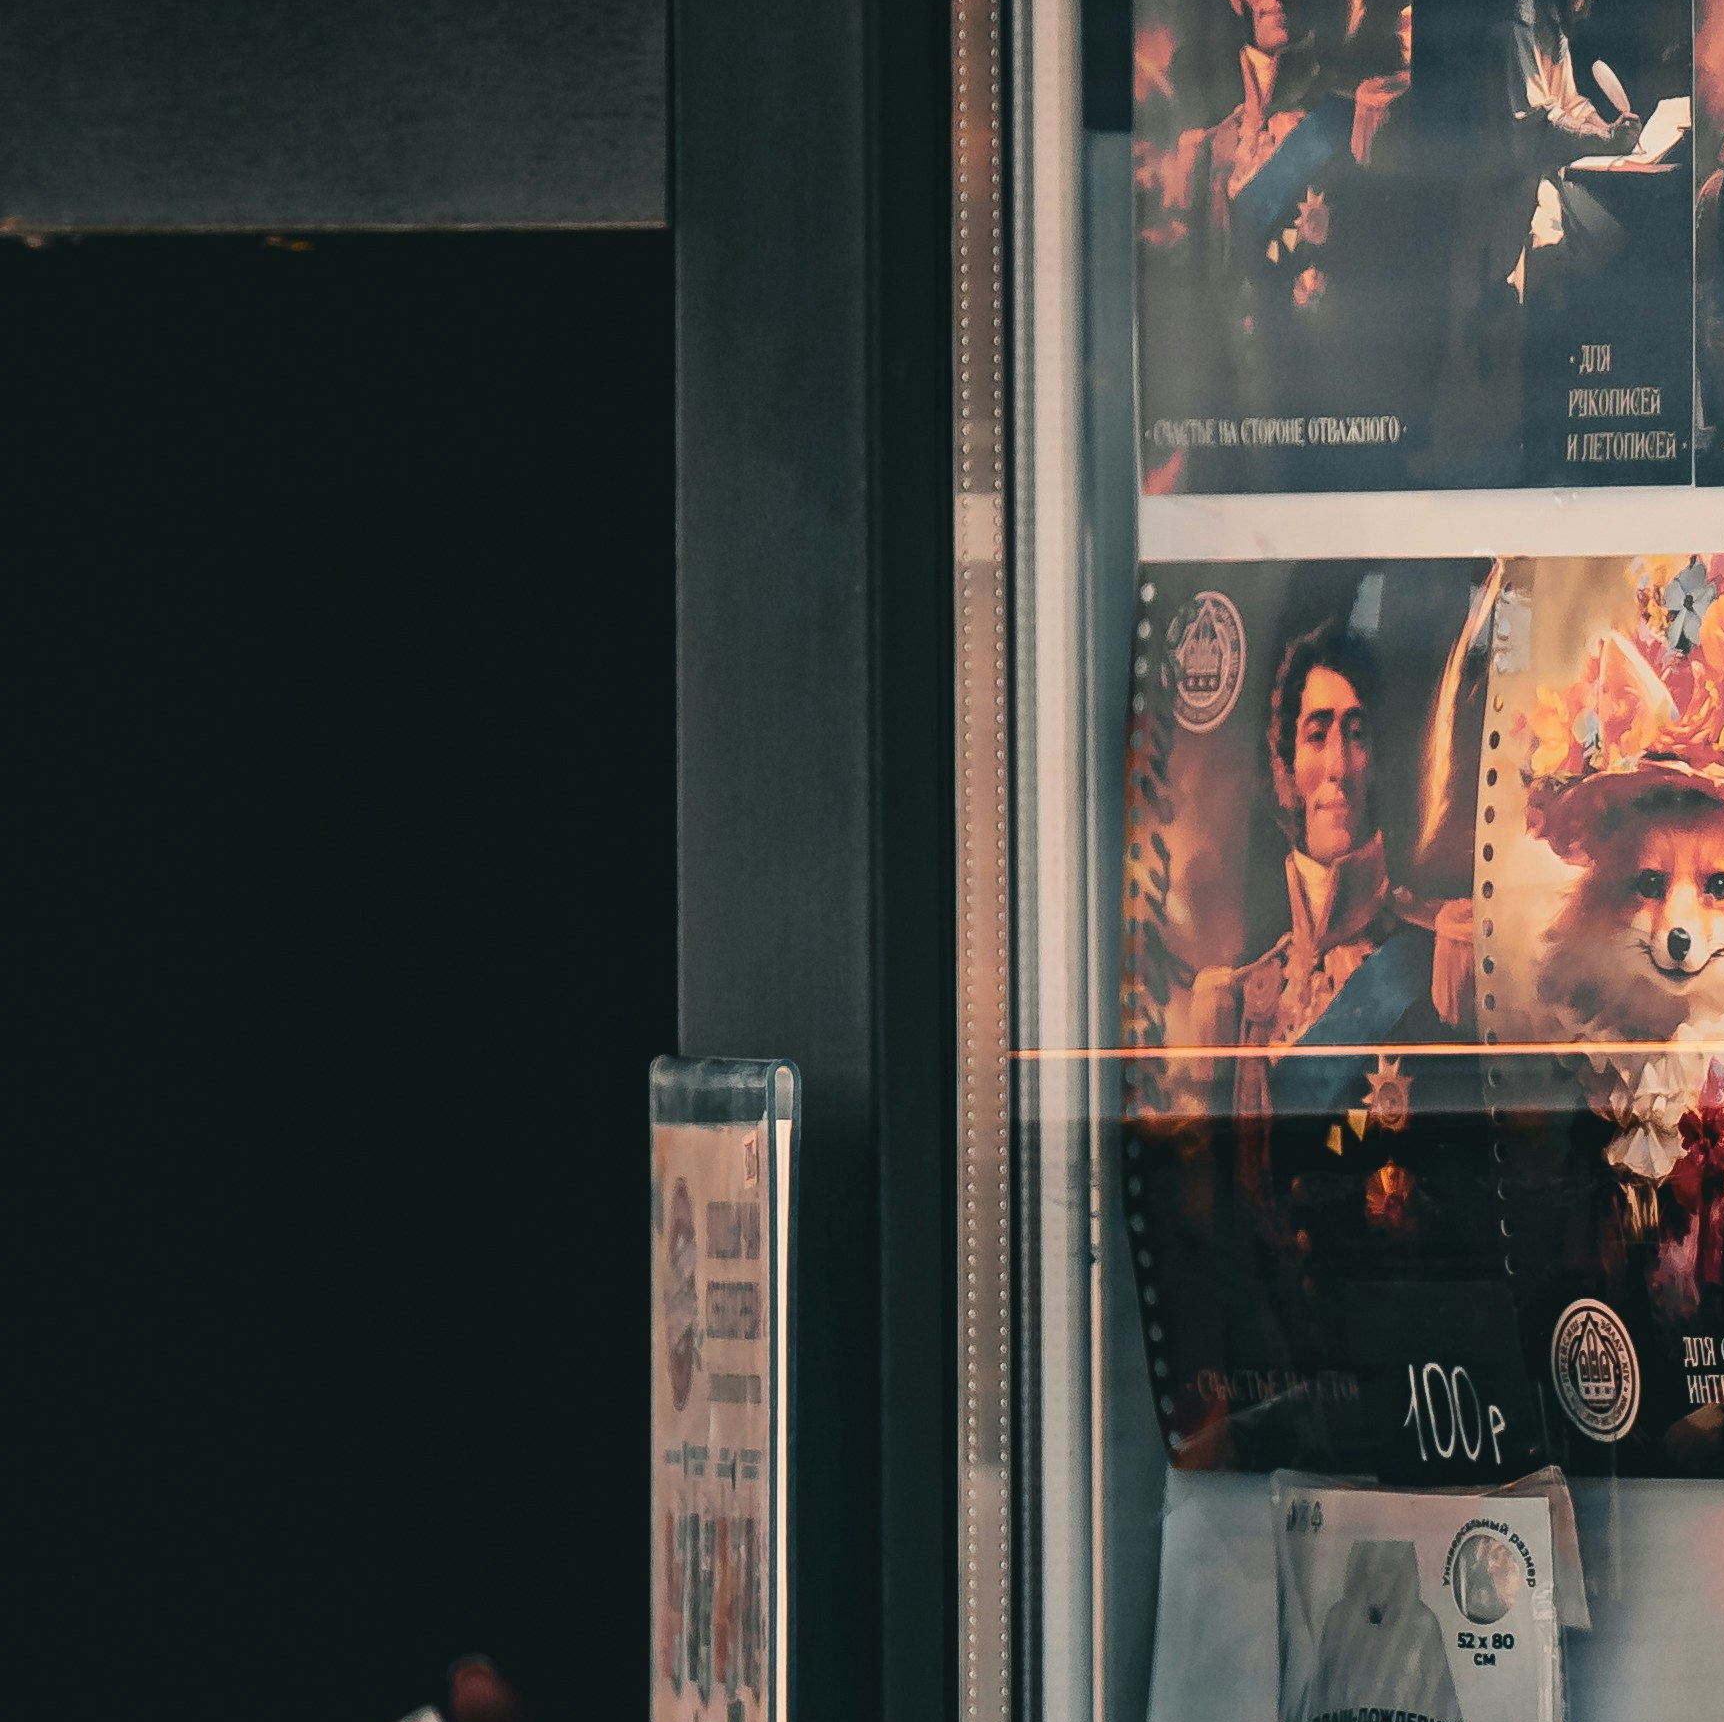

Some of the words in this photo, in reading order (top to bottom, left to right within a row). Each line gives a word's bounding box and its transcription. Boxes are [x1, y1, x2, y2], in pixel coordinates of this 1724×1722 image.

[1579, 344, 1612, 374] ДЛЯ
[1568, 386, 1661, 417] РУКОПИСЕЙ
[1308, 415, 1400, 445] ОТВАЖНОГО
[1566, 434, 1578, 461] И
[1582, 430, 1676, 461] ЛЕТОПИСЕЙ
[1683, 1336, 1717, 1368] ДЛЯ
[1457, 1632, 1476, 1649] 52
[1491, 1633, 1515, 1650] 80
